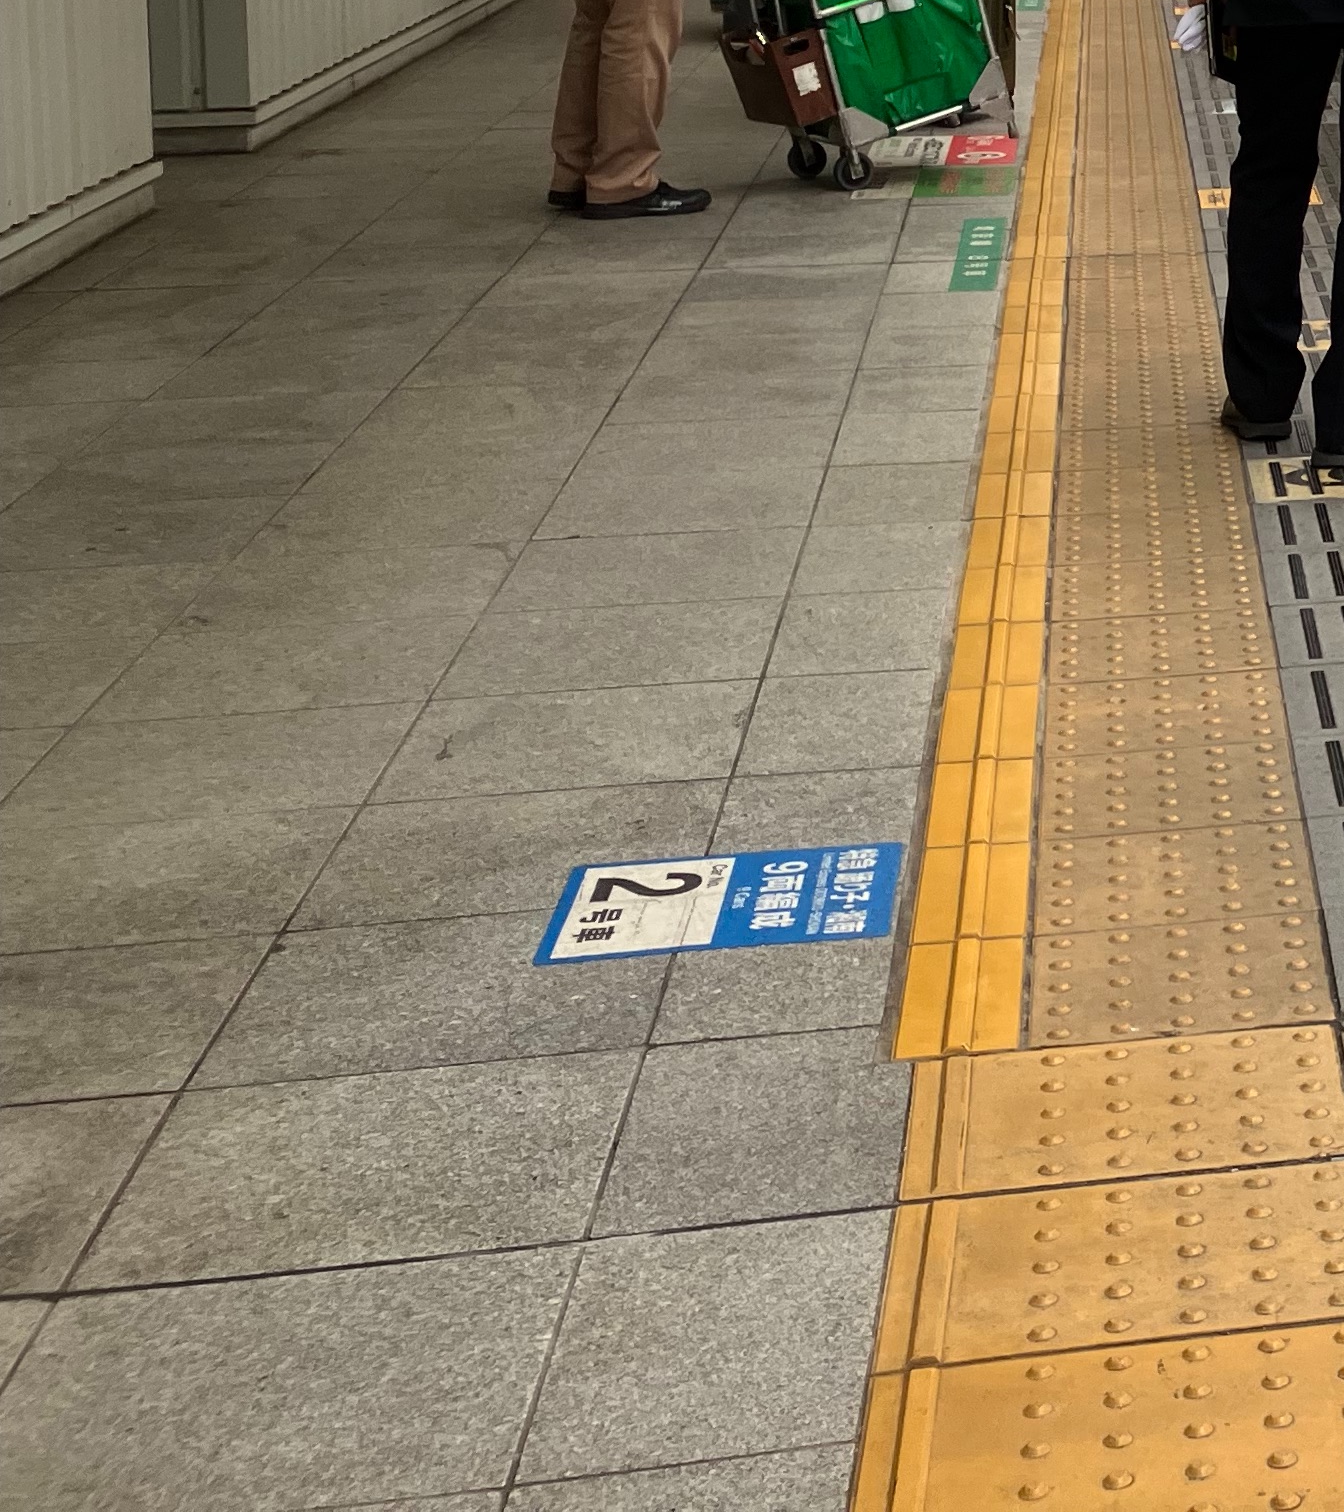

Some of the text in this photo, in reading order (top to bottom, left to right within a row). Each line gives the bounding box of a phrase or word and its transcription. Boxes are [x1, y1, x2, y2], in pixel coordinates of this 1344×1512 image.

[706, 863, 729, 888] Car No.
[571, 870, 704, 944] 2 号車
